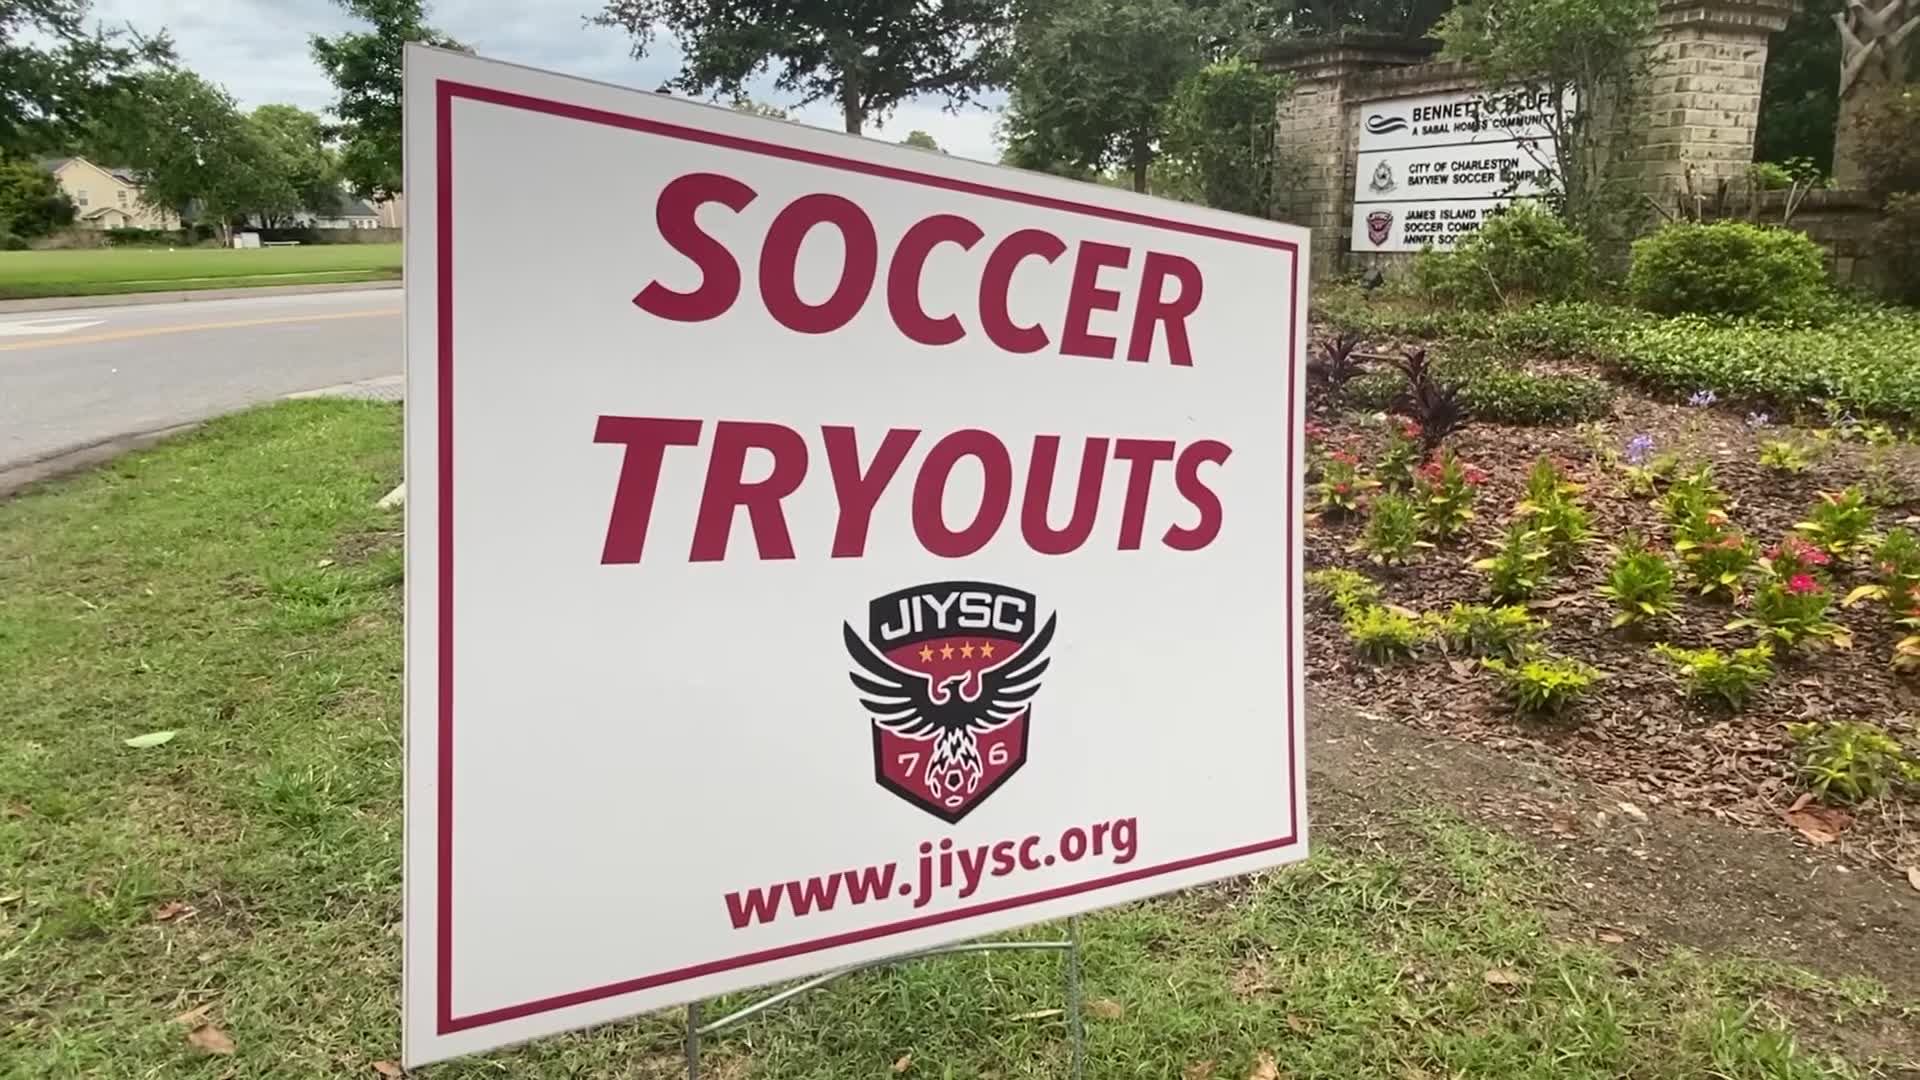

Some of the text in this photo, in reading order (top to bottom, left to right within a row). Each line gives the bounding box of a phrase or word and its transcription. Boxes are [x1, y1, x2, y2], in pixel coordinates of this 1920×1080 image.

[1412, 126, 1419, 136] A
[1422, 124, 1450, 136] SABAL
[1408, 158, 1519, 175] CITY OF CHARLESTON
[1408, 174, 1449, 186] BAYVIEW
[1452, 172, 1495, 185] SOCCER
[1405, 210, 1436, 220] JAMES
[1440, 208, 1477, 220] ISLAND
[1404, 222, 1443, 233] SOCCER
[633, 171, 1204, 368] SOCCER
[592, 415, 1233, 566] TRYOUTS
[880, 591, 1027, 641] JIYSC
[897, 741, 1008, 777] 7 6
[725, 816, 1138, 929] www.jiysc.org
